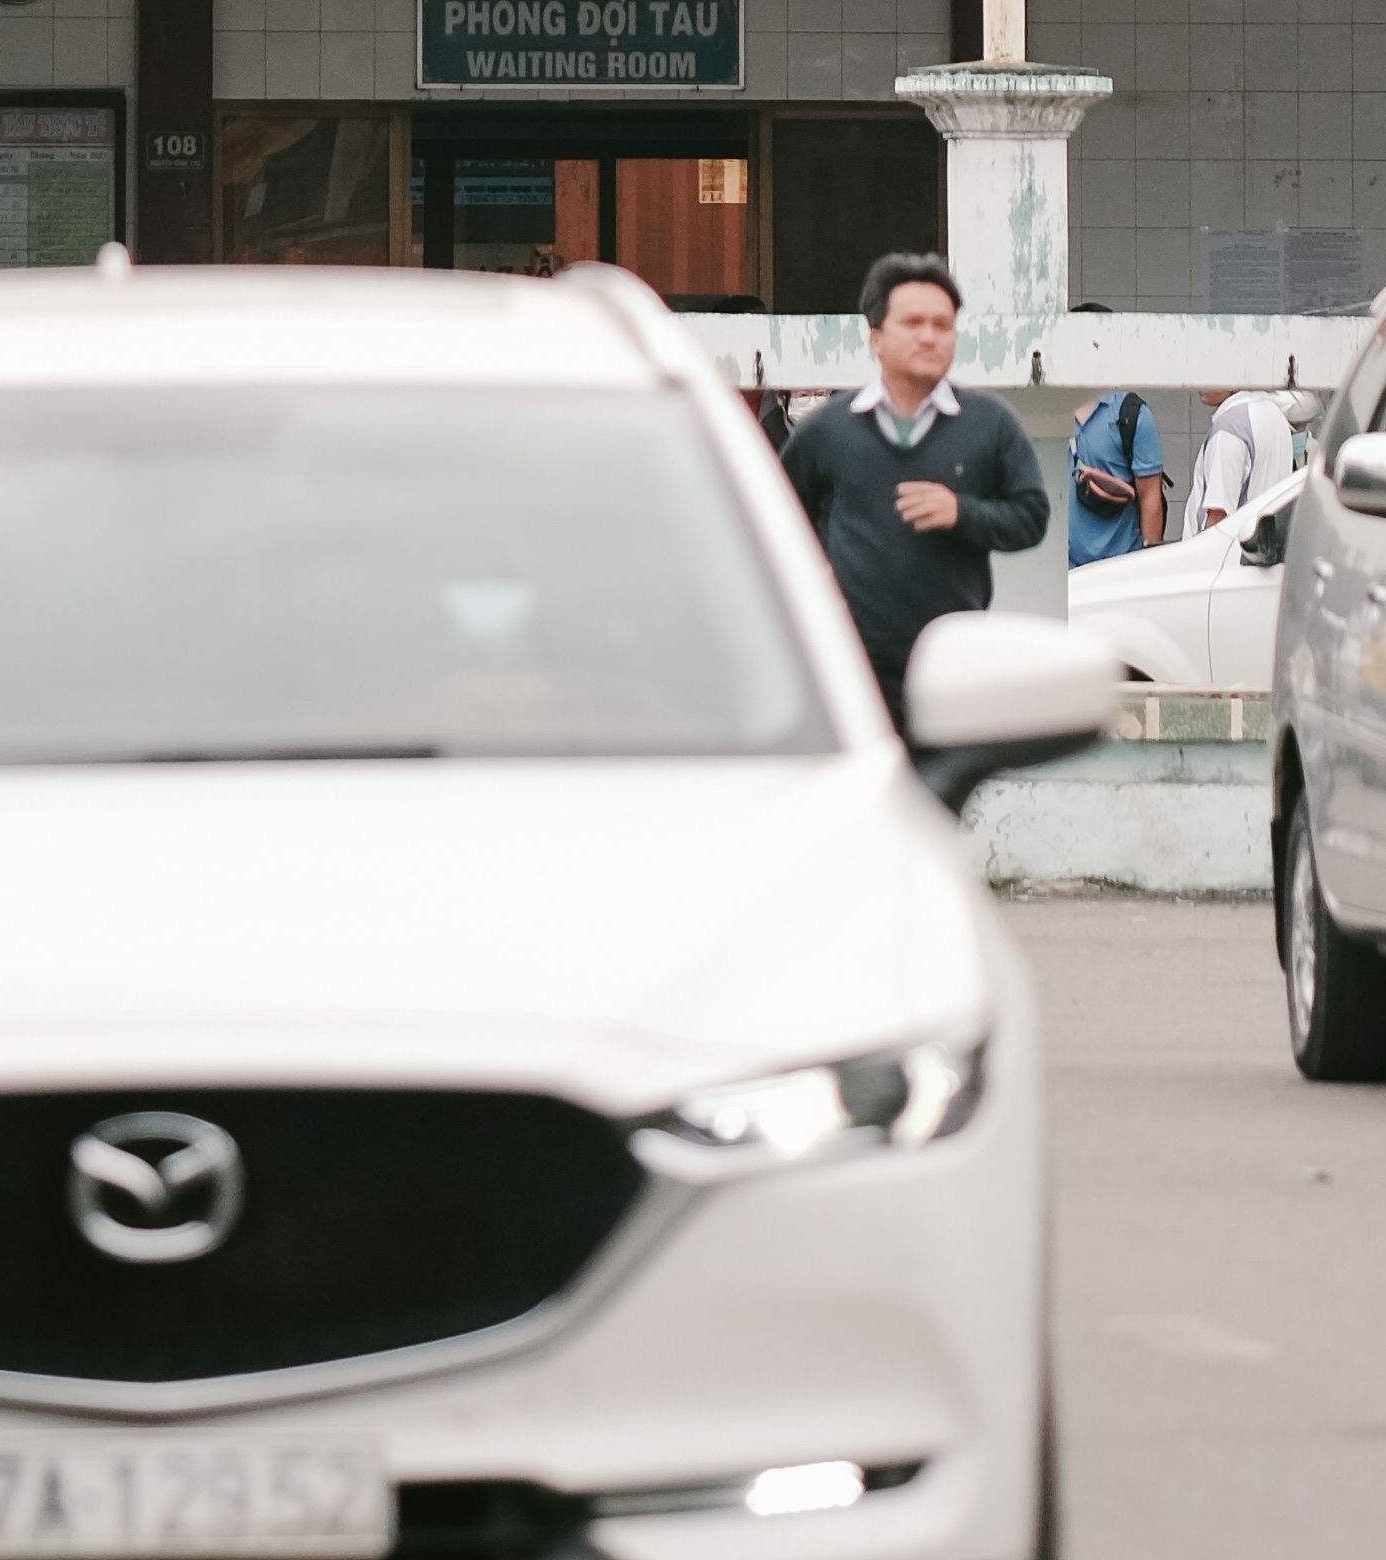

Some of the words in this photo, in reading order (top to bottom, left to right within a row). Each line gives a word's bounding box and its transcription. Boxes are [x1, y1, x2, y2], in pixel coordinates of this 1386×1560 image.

[467, 51, 598, 79] WAITING
[607, 51, 697, 80] ROOM
[153, 135, 197, 156] 108
